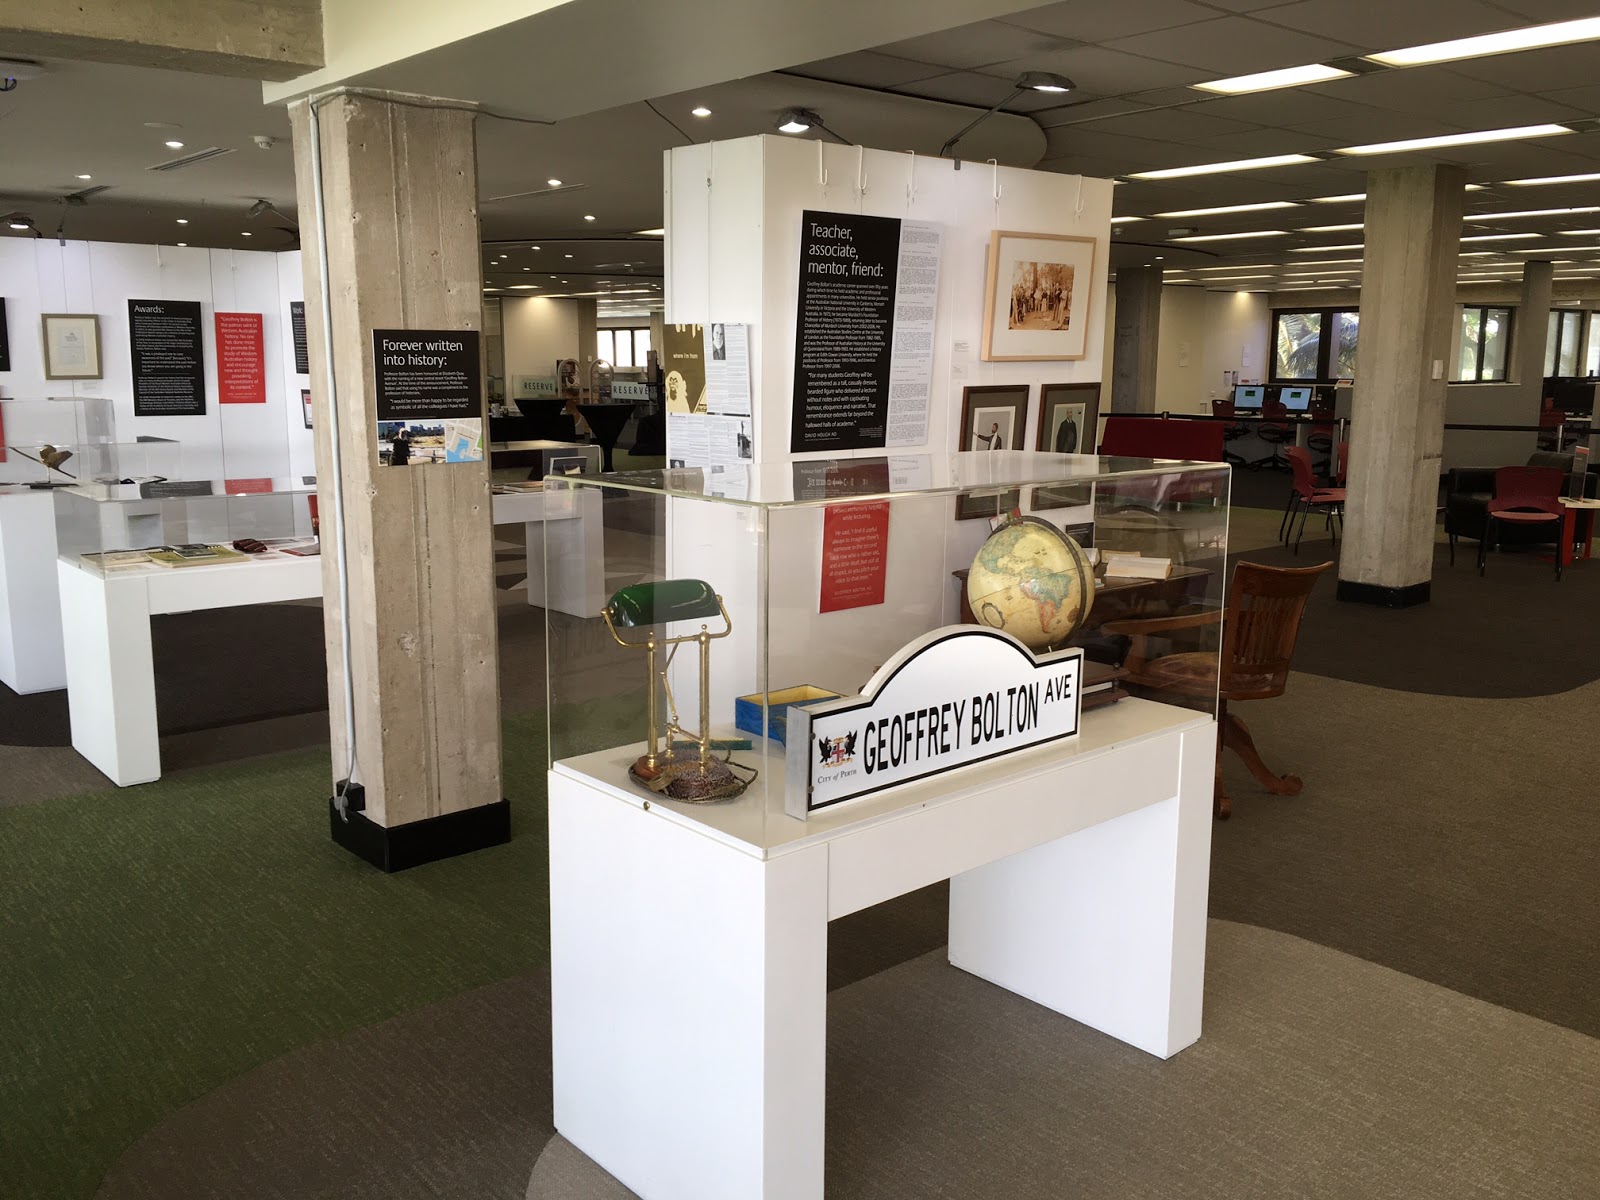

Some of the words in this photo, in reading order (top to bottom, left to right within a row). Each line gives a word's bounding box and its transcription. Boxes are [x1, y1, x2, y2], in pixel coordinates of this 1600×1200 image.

[810, 222, 853, 241] Teacher,
[808, 243, 858, 260] associate,
[808, 262, 849, 277] mentor,
[852, 262, 884, 277] friend:
[134, 305, 165, 314] Awards:
[382, 339, 423, 351] Forever
[426, 340, 463, 351] written
[383, 354, 405, 366] into
[408, 354, 447, 368] history:
[524, 382, 553, 391] RESERVE
[613, 386, 649, 395] RESERVE
[863, 699, 966, 775] GEOFFREY
[971, 682, 1039, 745] BOLTON
[1044, 674, 1072, 704] AVE
[832, 772, 839, 781] of
